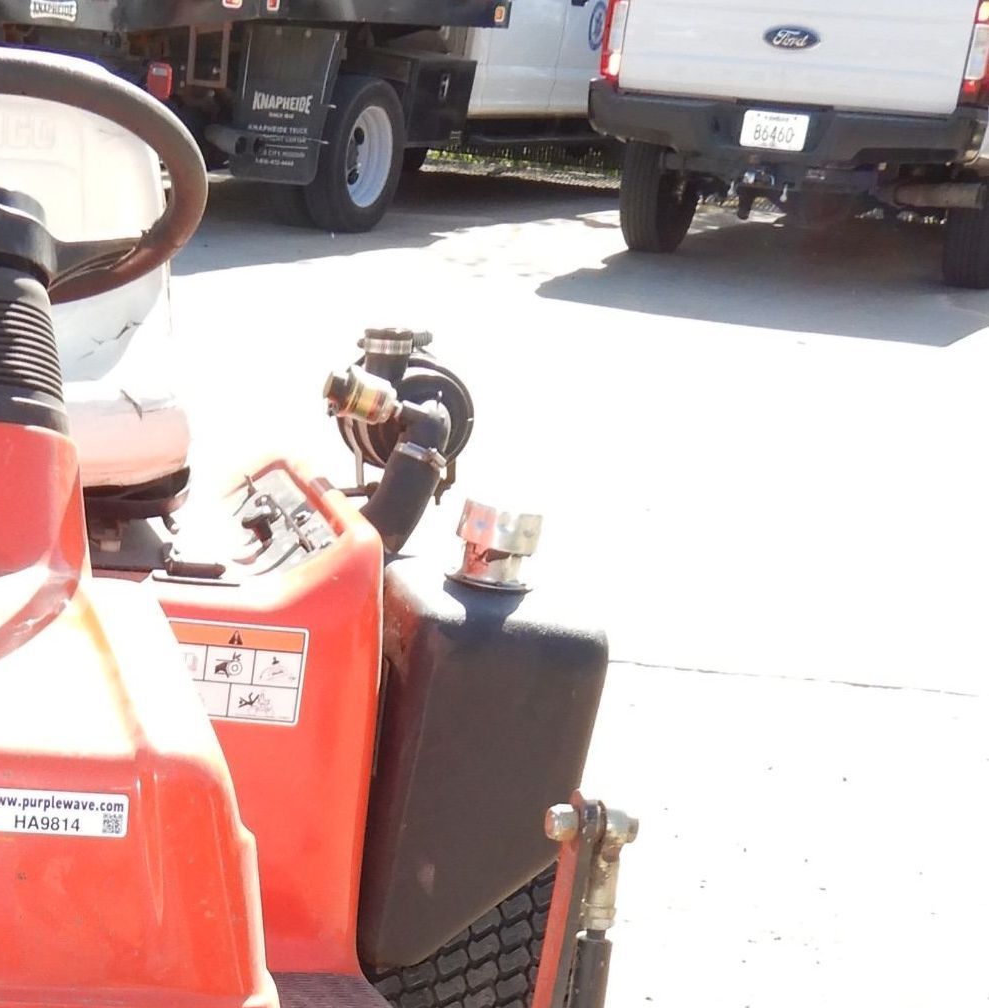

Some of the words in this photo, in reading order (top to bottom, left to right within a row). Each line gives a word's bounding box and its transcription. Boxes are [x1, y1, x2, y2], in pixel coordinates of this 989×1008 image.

[772, 29, 808, 47] Ford
[252, 91, 313, 115] KNAPHEIDE
[247, 124, 287, 134] KNAPHEIDE
[753, 124, 795, 144] 86460
[14, 815, 81, 832] HA9814
